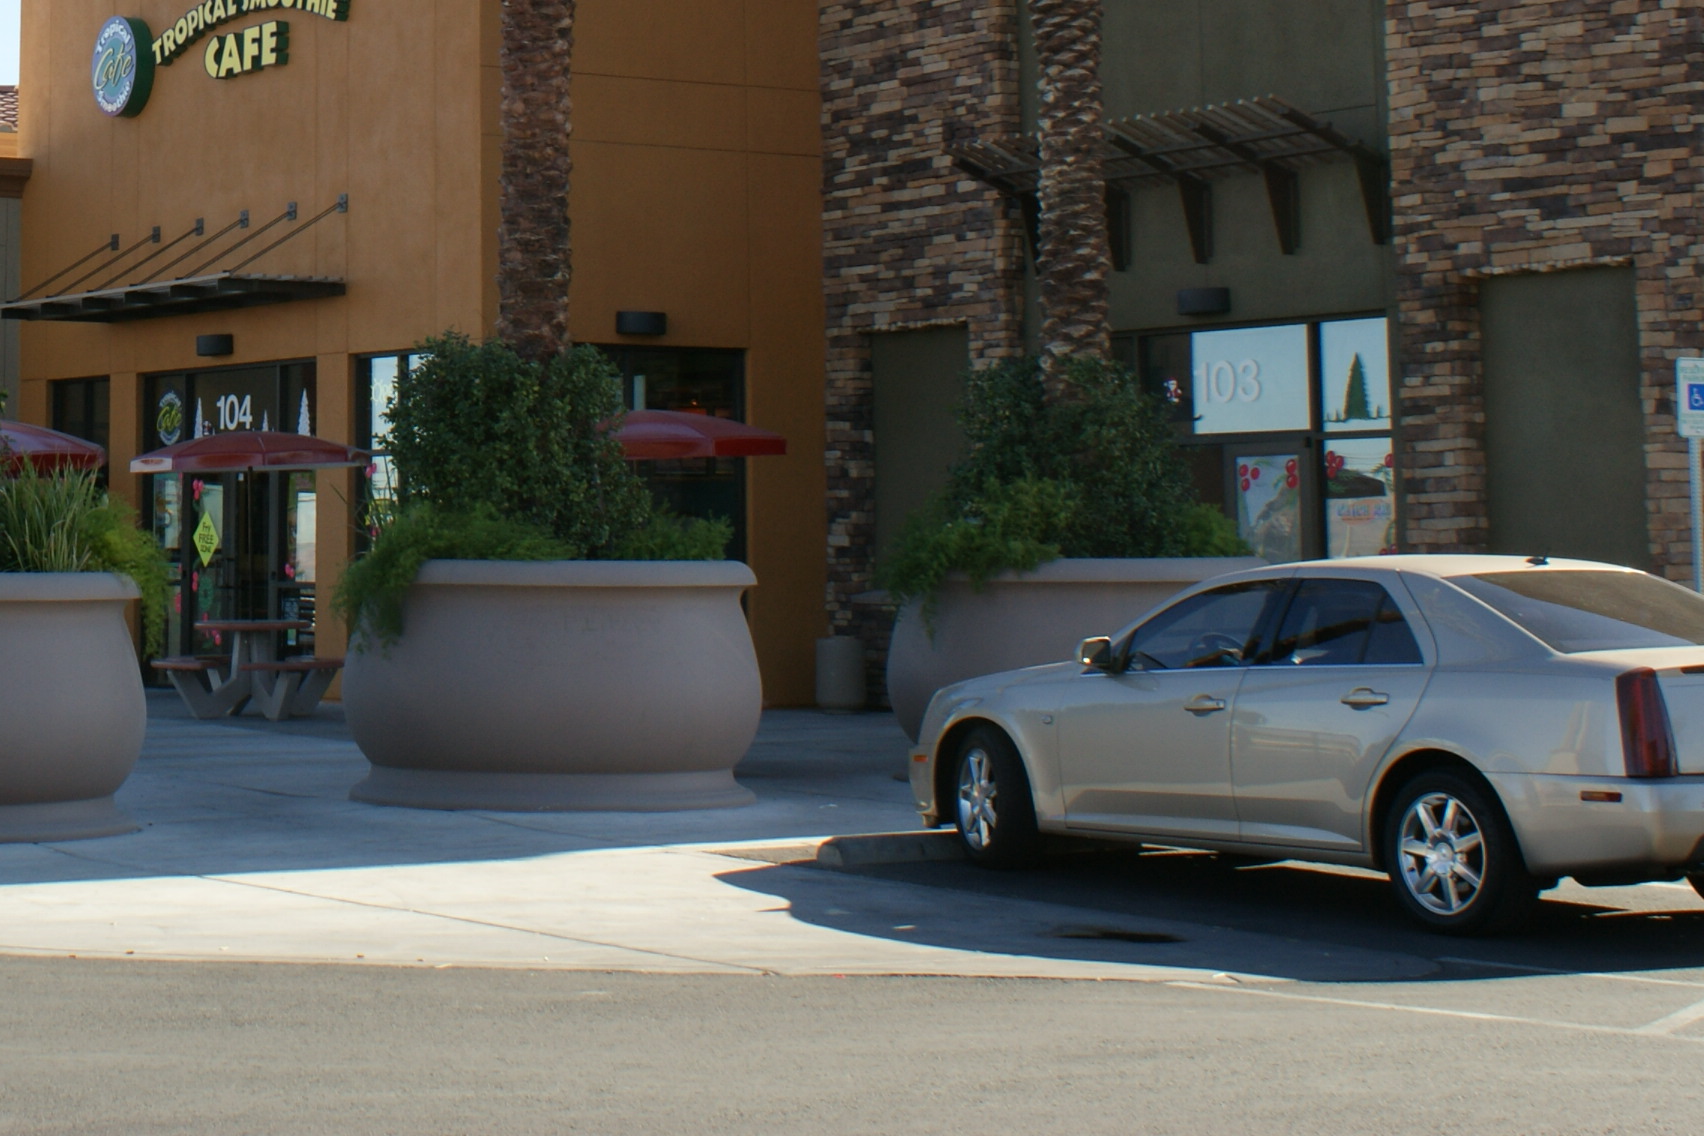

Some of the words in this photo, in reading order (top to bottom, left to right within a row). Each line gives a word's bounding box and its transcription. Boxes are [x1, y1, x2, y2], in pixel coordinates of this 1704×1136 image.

[204, 20, 278, 78] CAFE
[1194, 359, 1261, 404] 103
[216, 393, 253, 431] 104
